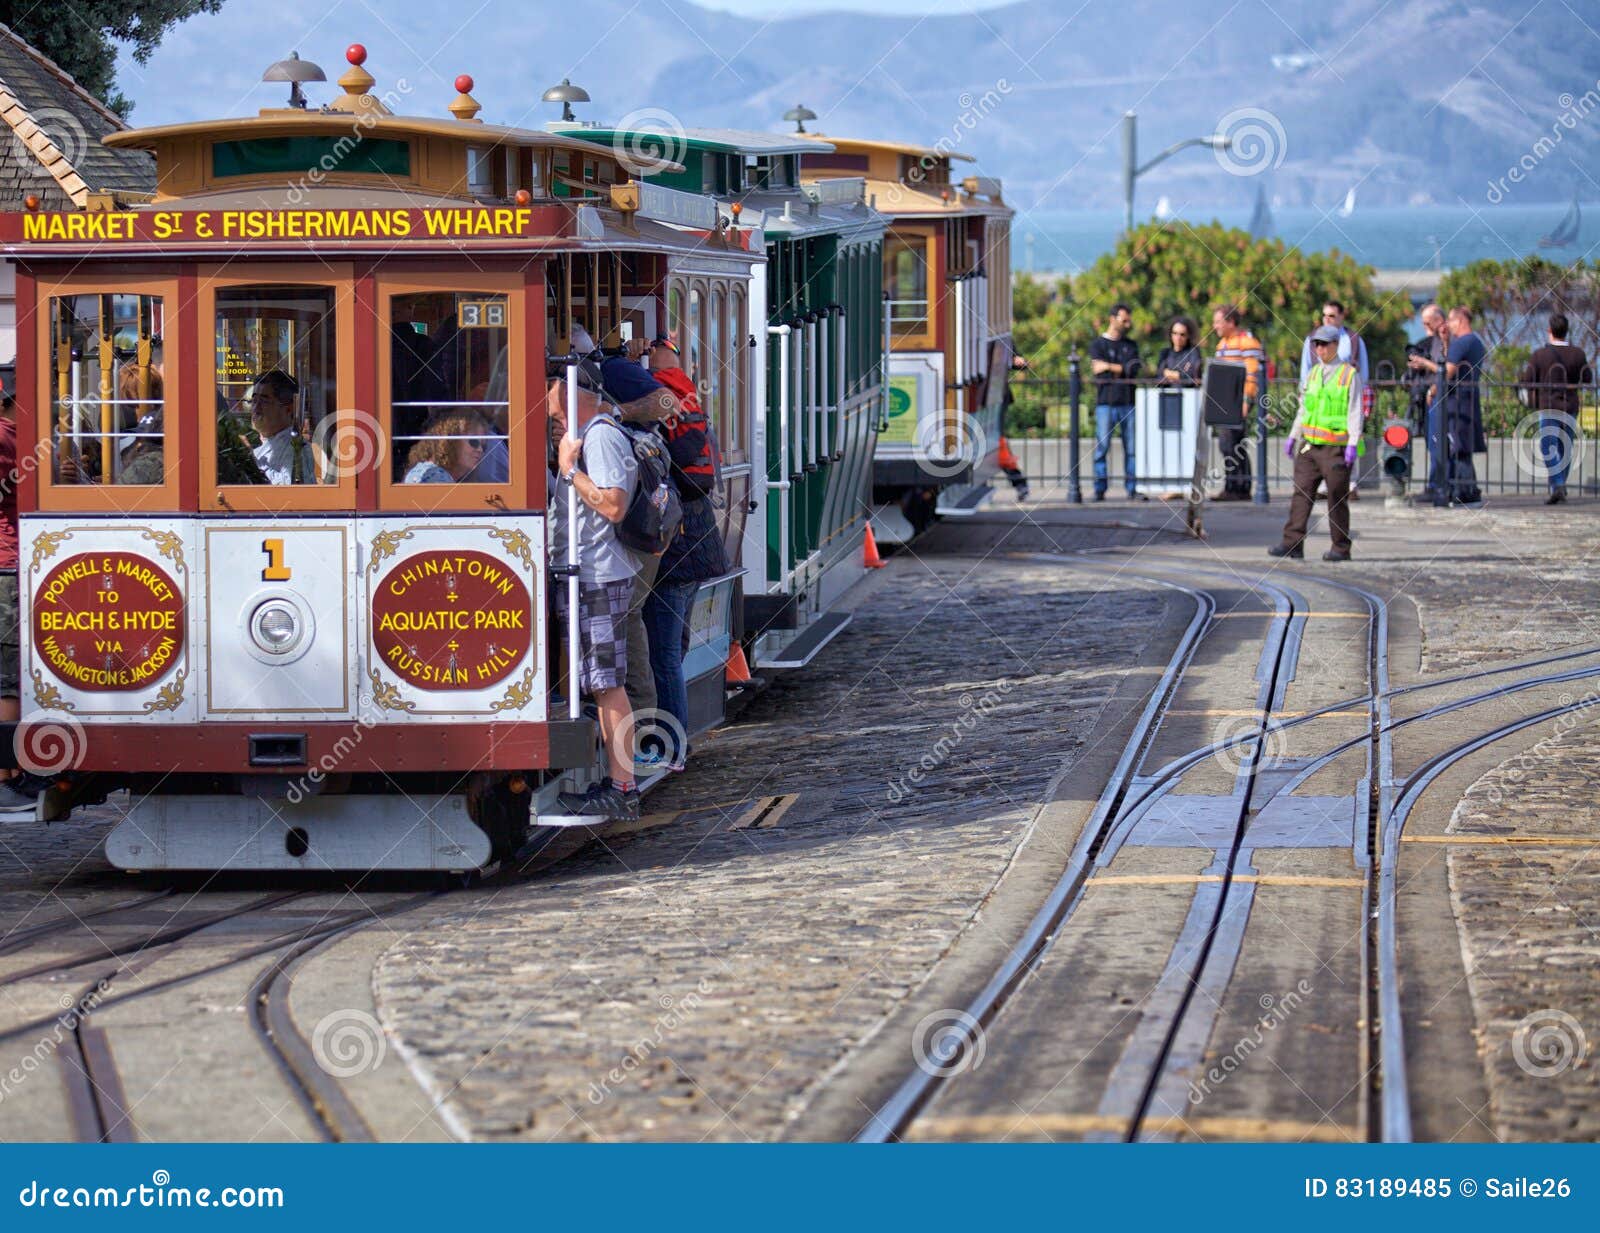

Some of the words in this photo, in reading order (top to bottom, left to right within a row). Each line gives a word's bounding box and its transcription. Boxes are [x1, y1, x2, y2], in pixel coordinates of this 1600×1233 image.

[23, 213, 138, 240] MARKET
[195, 212, 214, 238] &
[223, 210, 411, 238] FISHERMANS
[424, 208, 532, 236] WHARF
[463, 305, 503, 326] 38
[261, 538, 292, 582] 1
[44, 559, 100, 604] POWELL
[103, 558, 113, 573] &
[117, 559, 174, 602] MARKET
[390, 557, 514, 596] CHINATOWN
[97, 591, 119, 604] TO
[40, 611, 104, 631] BEACH
[108, 611, 120, 630] &
[123, 611, 176, 630] HYDE
[379, 610, 470, 632] AQUATIC
[474, 609, 524, 630] PARK
[42, 635, 118, 686] WASHINGTON
[120, 671, 129, 685] &
[130, 636, 176, 683] JACKSON
[95, 640, 123, 653] VIA
[388, 645, 469, 684] RUSSIAN
[476, 647, 518, 680] HILL
